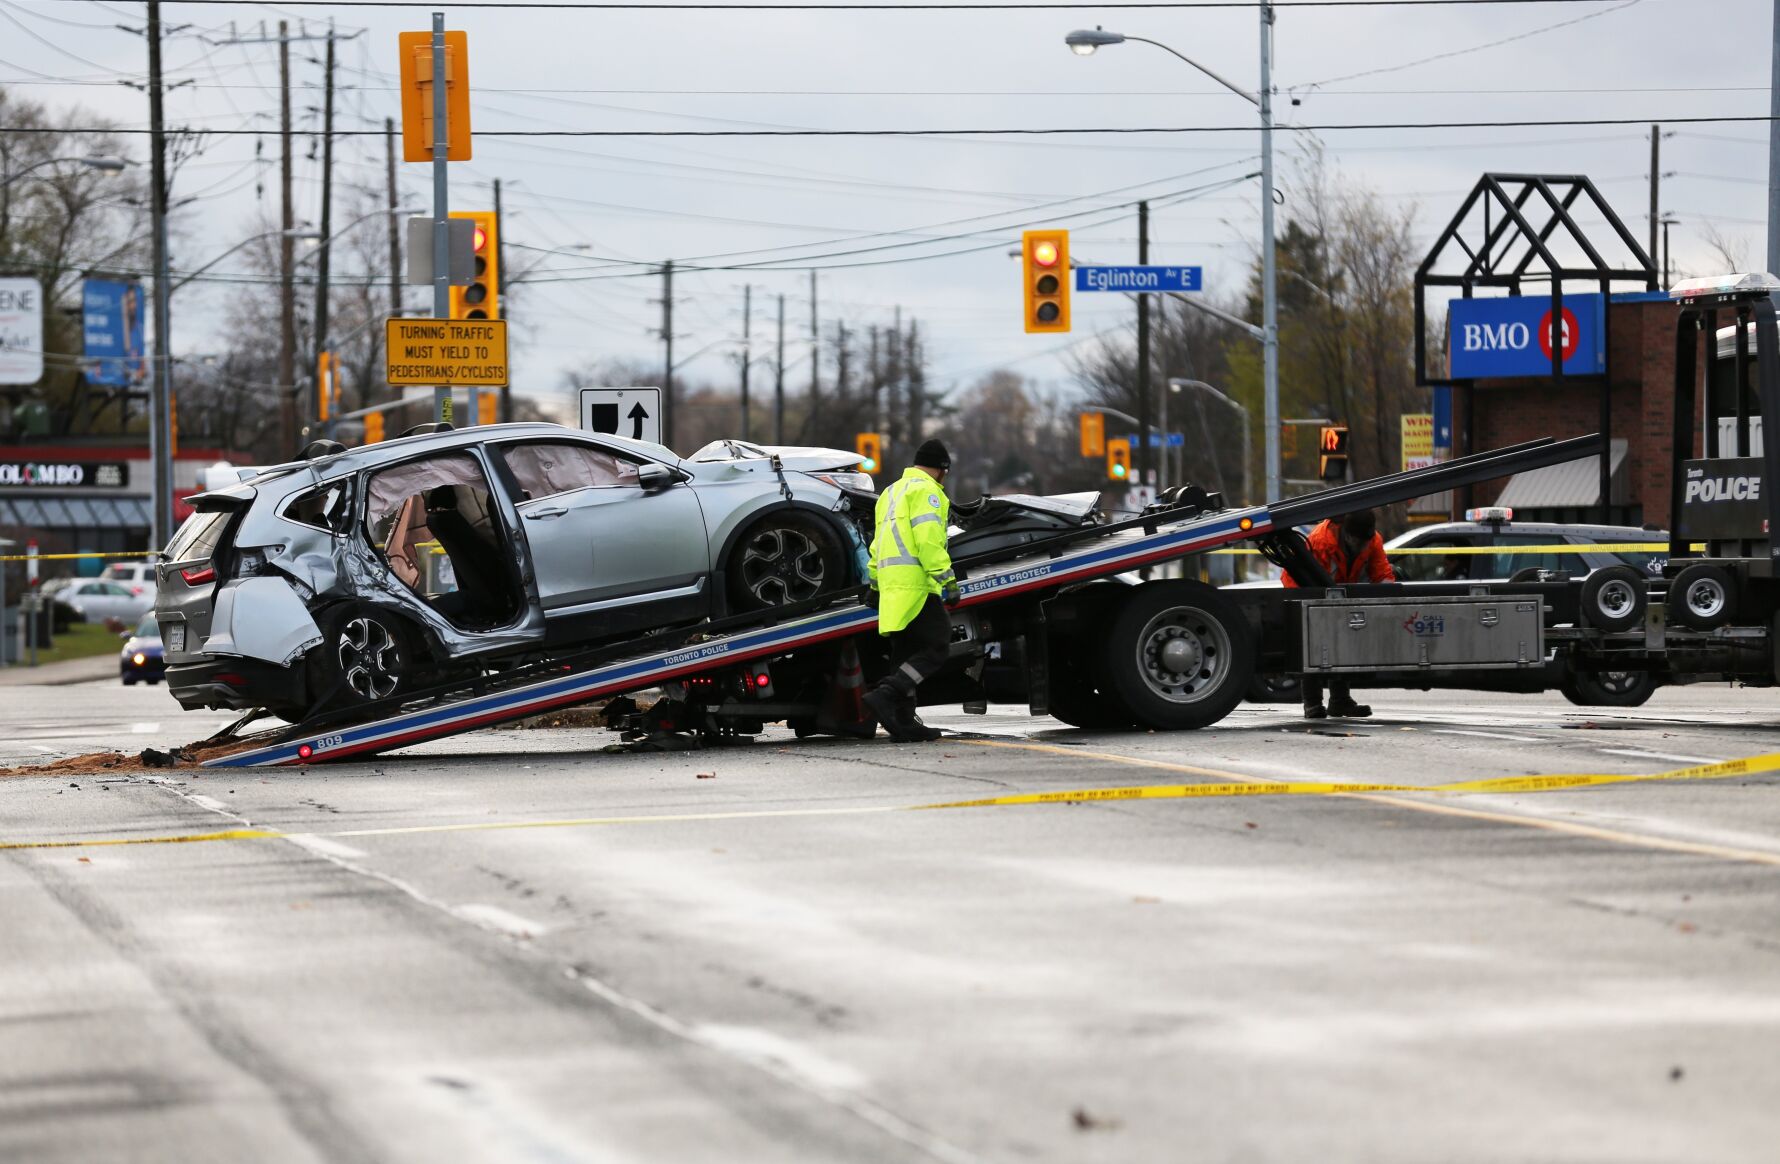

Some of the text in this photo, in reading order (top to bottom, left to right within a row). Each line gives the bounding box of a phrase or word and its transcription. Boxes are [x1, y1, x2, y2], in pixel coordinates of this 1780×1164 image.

[1087, 269, 1191, 290] Eglinton Av E
[400, 326, 494, 340] TURNING TRAFFIC
[1463, 322, 1530, 351] BMO
[405, 346, 488, 359] MUST YIELD TO
[389, 365, 504, 379] PEDESTRIANS/CYCLISTS
[1685, 477, 1761, 504] POLICE
[969, 579, 998, 591] SERVE
[1000, 576, 1009, 585] &
[1009, 565, 1052, 583] PROTECT
[663, 643, 729, 665] TORONTO POLICE
[317, 735, 343, 748] 809
